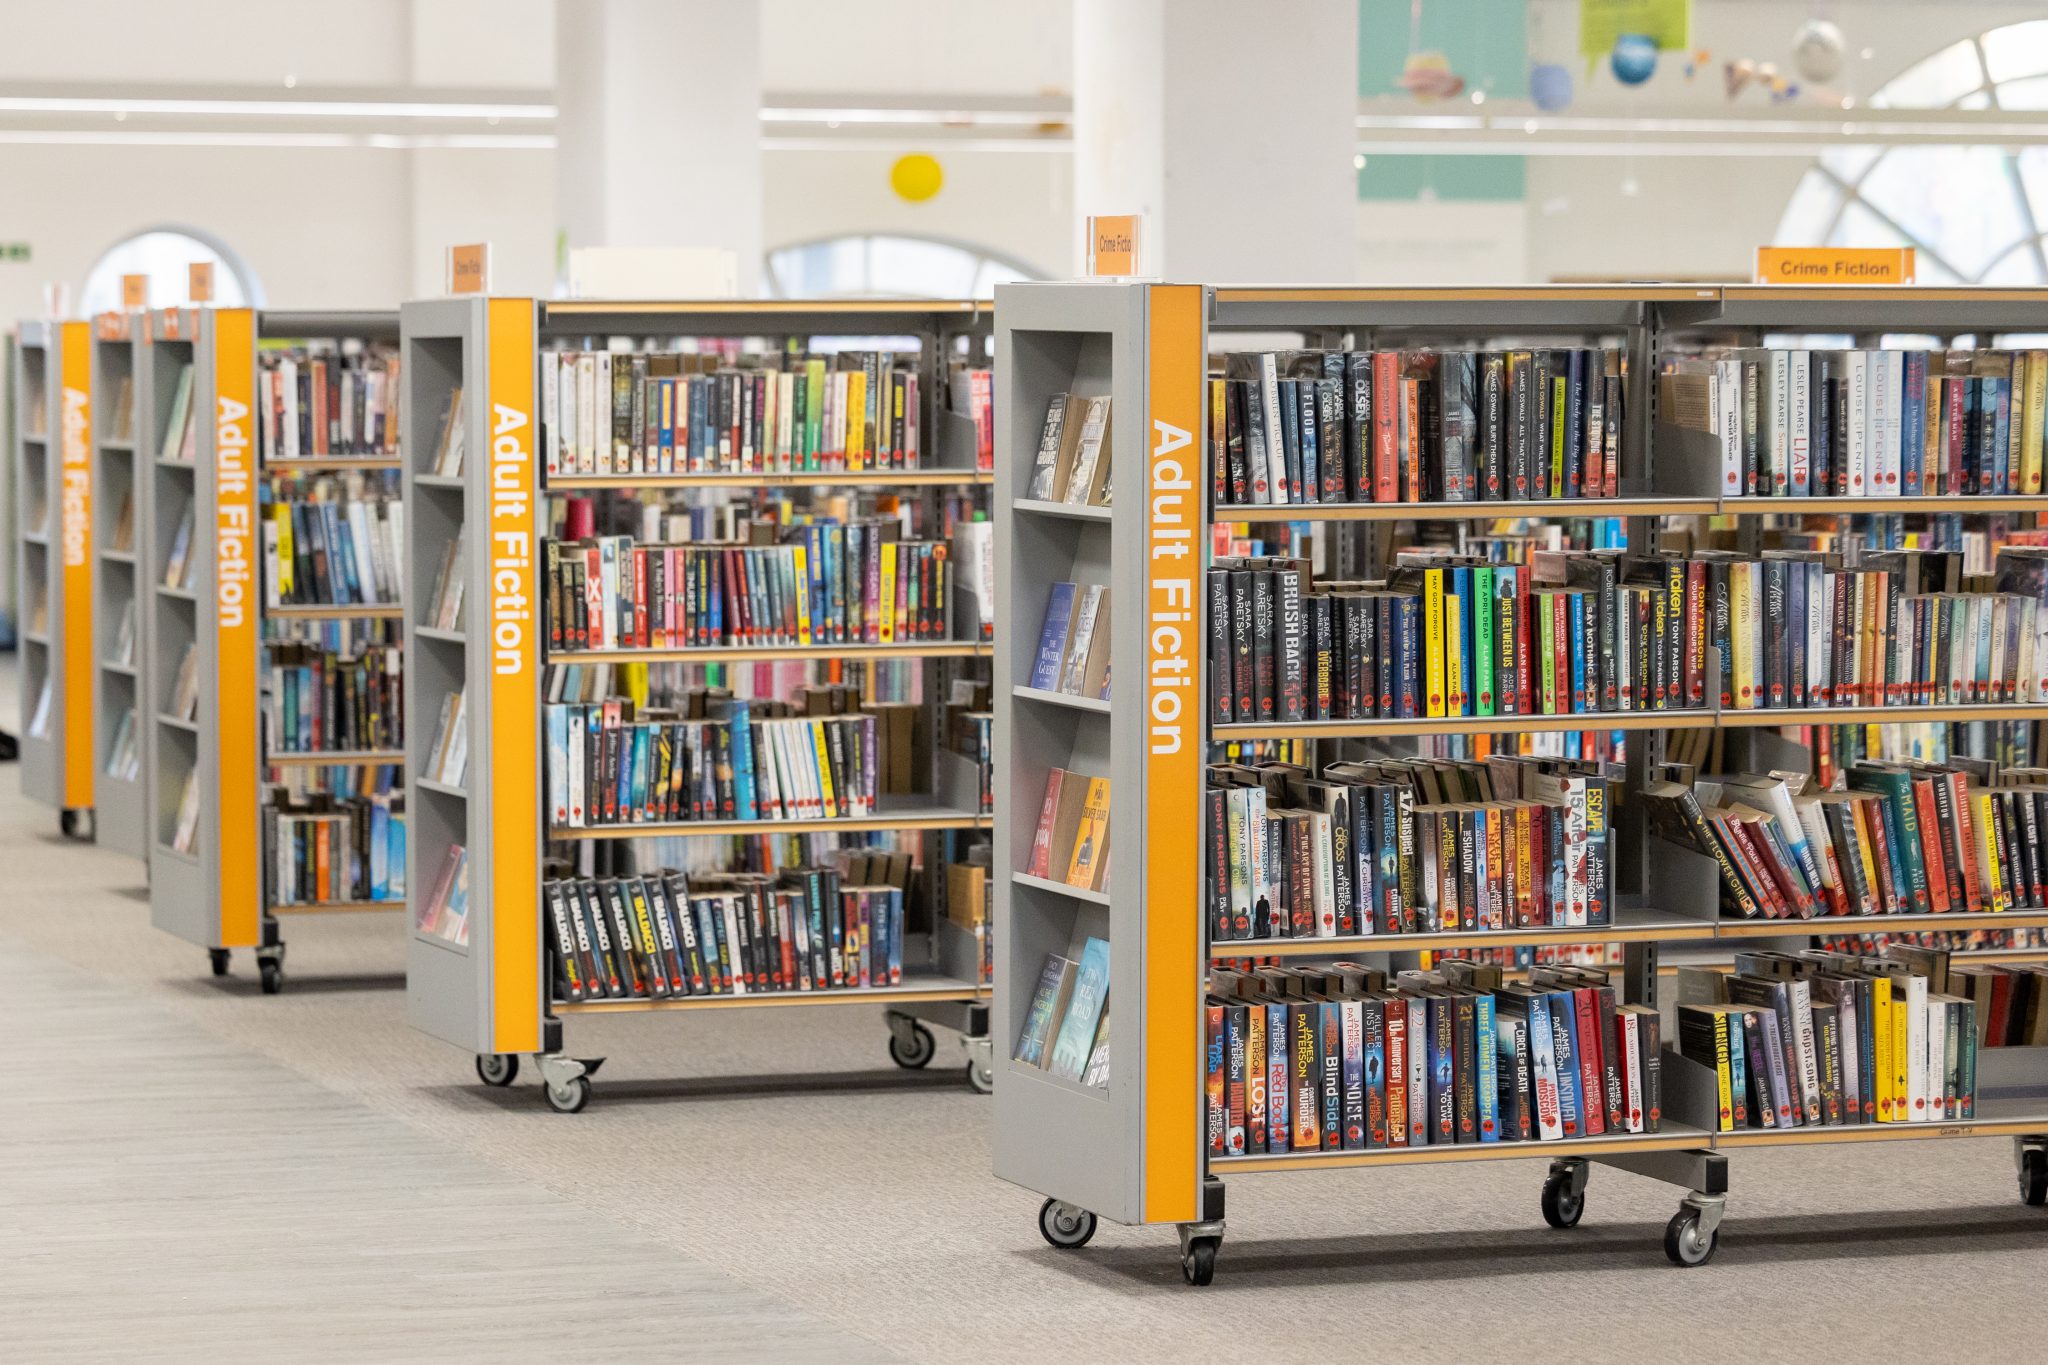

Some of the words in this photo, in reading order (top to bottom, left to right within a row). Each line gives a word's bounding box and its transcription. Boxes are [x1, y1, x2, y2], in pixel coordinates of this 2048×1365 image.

[1100, 234, 1115, 252] Crime
[1117, 234, 1131, 252] Fictio
[1781, 261, 1828, 275] Crime
[1834, 261, 1889, 275] Fiction
[1355, 380, 1365, 420] OLSEN
[1573, 399, 1581, 418] Body
[1855, 365, 1863, 416] LOUISE
[1876, 365, 1884, 415] LOUISE
[63, 388, 90, 458] Adult
[1304, 394, 1313, 435] FLOOD
[1591, 405, 1602, 419] THE
[218, 397, 250, 494] Adult
[494, 404, 528, 517] Adult
[1794, 438, 1807, 477] LIAR
[1152, 420, 1192, 560] Adult
[63, 466, 90, 566] Fiction
[218, 506, 250, 627] Fiction
[494, 532, 530, 675] Fiction
[1215, 583, 1223, 640] PARETSKY
[1257, 583, 1265, 639] PARETSKY
[1284, 575, 1299, 633] BRUSH
[1502, 598, 1512, 615] JUST
[1670, 566, 1683, 617] #taken
[1769, 590, 1778, 618] PERRY
[1236, 588, 1244, 641] PARETSKY
[1656, 594, 1666, 637] #taken
[1503, 618, 1512, 655] BETWEEN
[1152, 581, 1192, 755] Fiction
[1286, 637, 1299, 680] BACK
[1503, 657, 1513, 667] US
[1938, 783, 1949, 818] UNDERTOW
[1957, 780, 1966, 792] THE
[1383, 793, 1391, 850] PATTERSON
[1587, 788, 1603, 832] ESCAPE
[1901, 794, 1915, 832] MAID
[1959, 795, 1969, 828] LISTENERS
[1216, 835, 1226, 893] PARSONS
[1463, 837, 1473, 873] SHADOW
[1587, 845, 1596, 902] PATTERSON
[1701, 825, 1712, 839] THE
[1709, 840, 1734, 879] FLOWER
[1336, 865, 1345, 918] PATTERSON
[1479, 1002, 1488, 1031] THREE
[1208, 1044, 1216, 1072] LIAR
[1298, 1014, 1306, 1077] PATTERSON
[1389, 1037, 1404, 1083] Anniversary
[1480, 1035, 1489, 1070] WOMEN
[1516, 1029, 1527, 1058] CIRCLE
[1552, 1016, 1564, 1070] PATTERSON
[1561, 1028, 1570, 1059] JAMES
[1714, 1016, 1728, 1064] SILENCED
[1831, 1047, 1837, 1055] TO
[1272, 1064, 1284, 1092] Red
[1440, 1092, 1447, 1103] TO
[1518, 1066, 1528, 1092] DEATH
[1559, 1072, 1576, 1121] UNSOLVED
[1807, 1063, 1815, 1089] SONG
[1230, 1082, 1243, 1126] HAUNTED
[1251, 1077, 1265, 1125] LOST
[1299, 1088, 1309, 1135] MURDERS
[1346, 1082, 1362, 1120] NOISE
[1537, 1078, 1550, 1123] MOSCOW
[1549, 1084, 1557, 1115] PRIVATE
